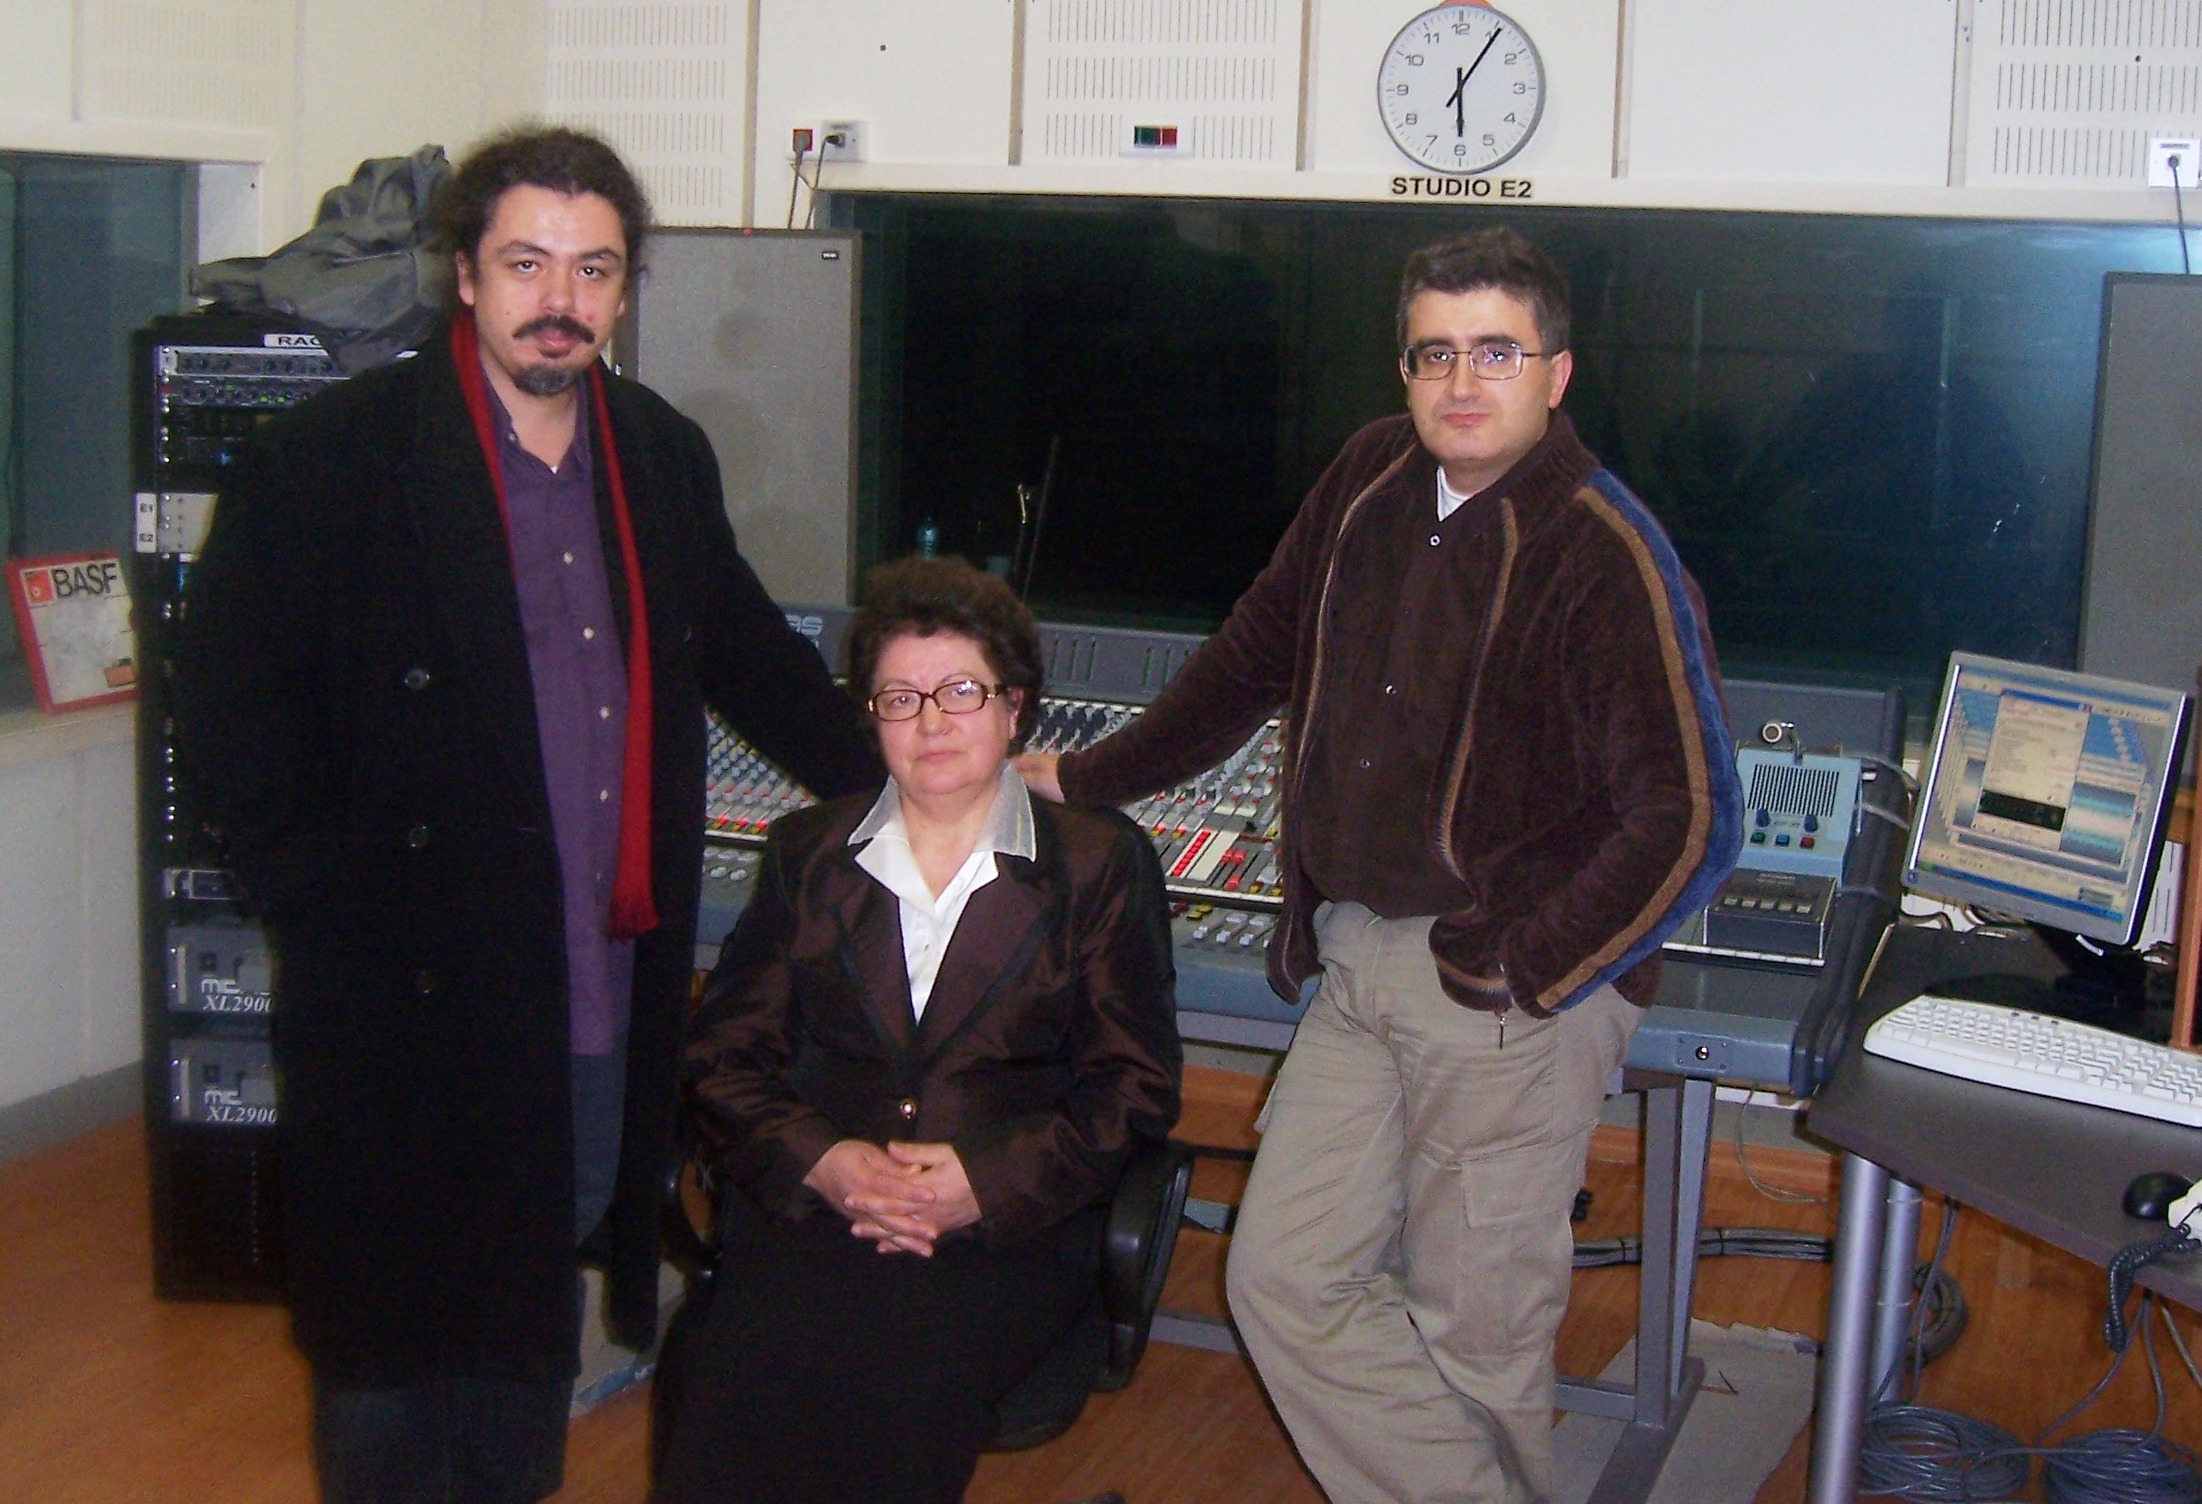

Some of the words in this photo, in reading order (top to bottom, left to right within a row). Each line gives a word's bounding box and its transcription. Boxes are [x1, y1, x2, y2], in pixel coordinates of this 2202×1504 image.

[1451, 23, 1471, 36] 12
[1423, 32, 1440, 44] 11
[1404, 54, 1424, 67] 10
[1504, 53, 1517, 65] 2
[1396, 84, 1409, 96] 9
[1513, 82, 1526, 95] 3
[1405, 113, 1418, 125] 8
[1503, 112, 1516, 124] 4
[1426, 134, 1438, 146] 7
[1482, 134, 1495, 146] 5
[1454, 144, 1466, 156] 6
[1391, 176, 1491, 197] STUDIO
[1500, 180, 1532, 198] E2
[50, 562, 118, 597] BASF
